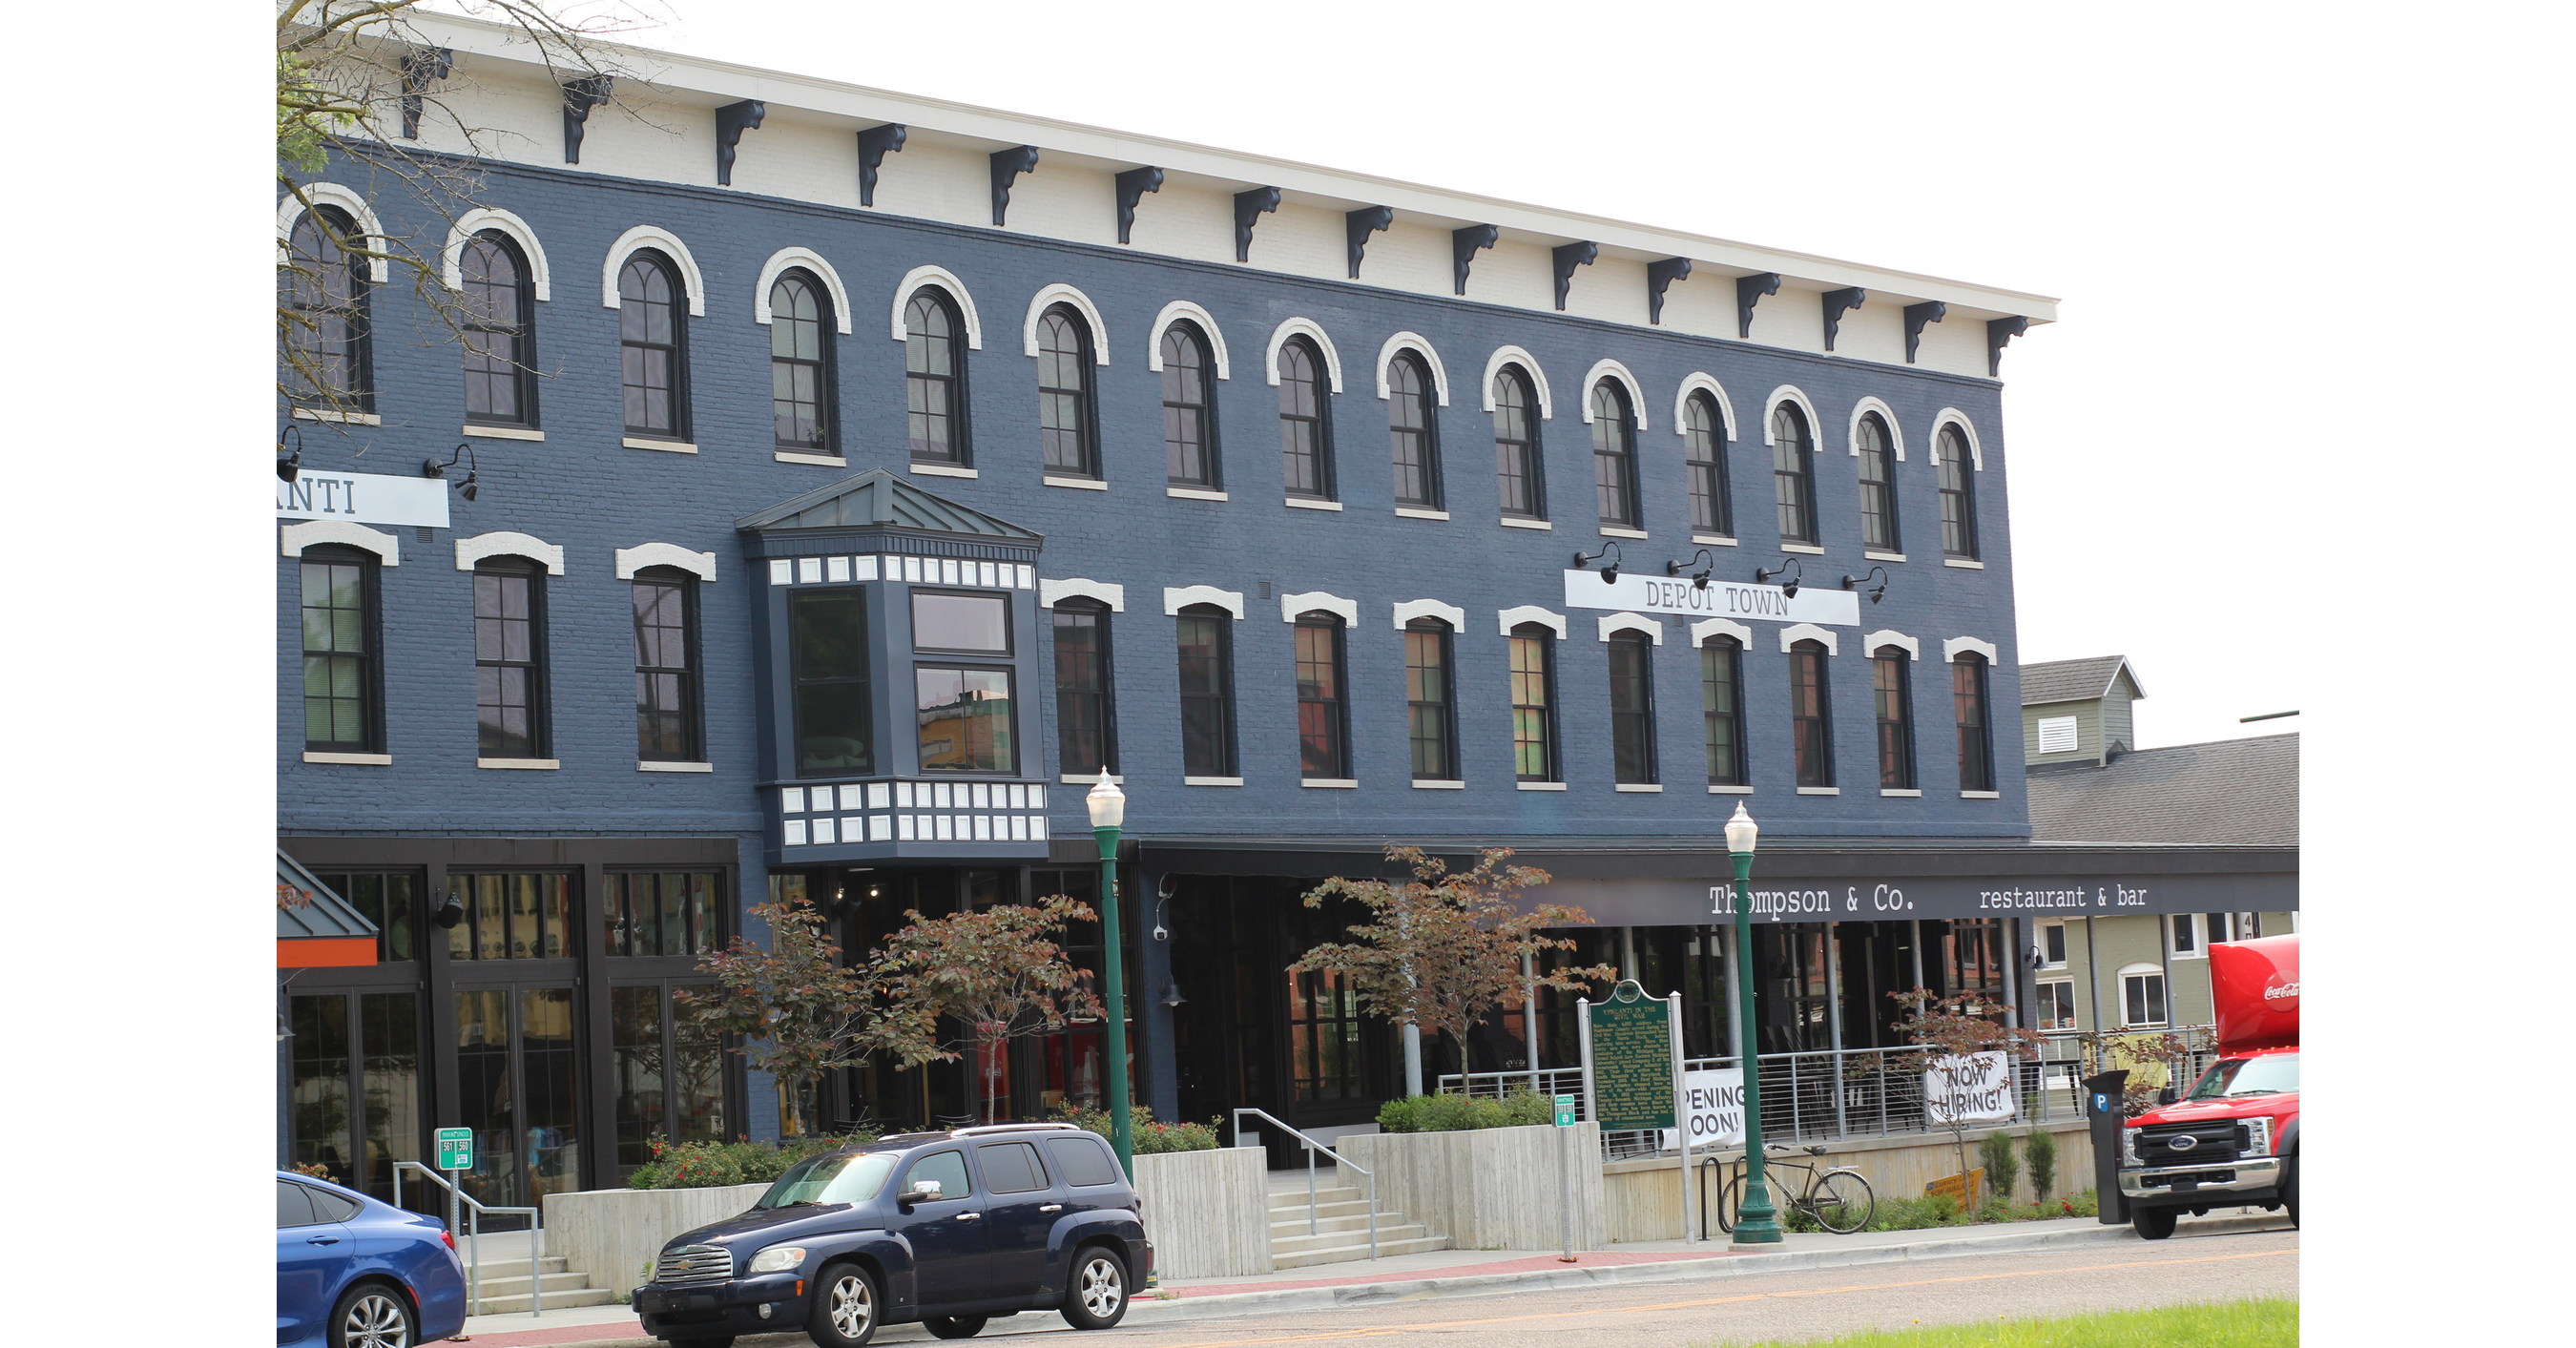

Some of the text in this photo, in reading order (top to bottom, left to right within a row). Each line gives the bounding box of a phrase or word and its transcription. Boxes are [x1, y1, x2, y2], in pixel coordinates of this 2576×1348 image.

[1646, 580, 1789, 616] DEPOT TOWN
[1846, 886, 1859, 912] &
[1874, 883, 1914, 912] Co.
[1980, 883, 2148, 909] restaurant & bar
[1947, 1066, 1987, 1088] NOW
[1686, 1086, 1745, 1110] ENING
[1939, 1089, 2003, 1115] HIRING!
[2097, 1094, 2107, 1110] P
[1688, 1111, 1739, 1136] OON!
